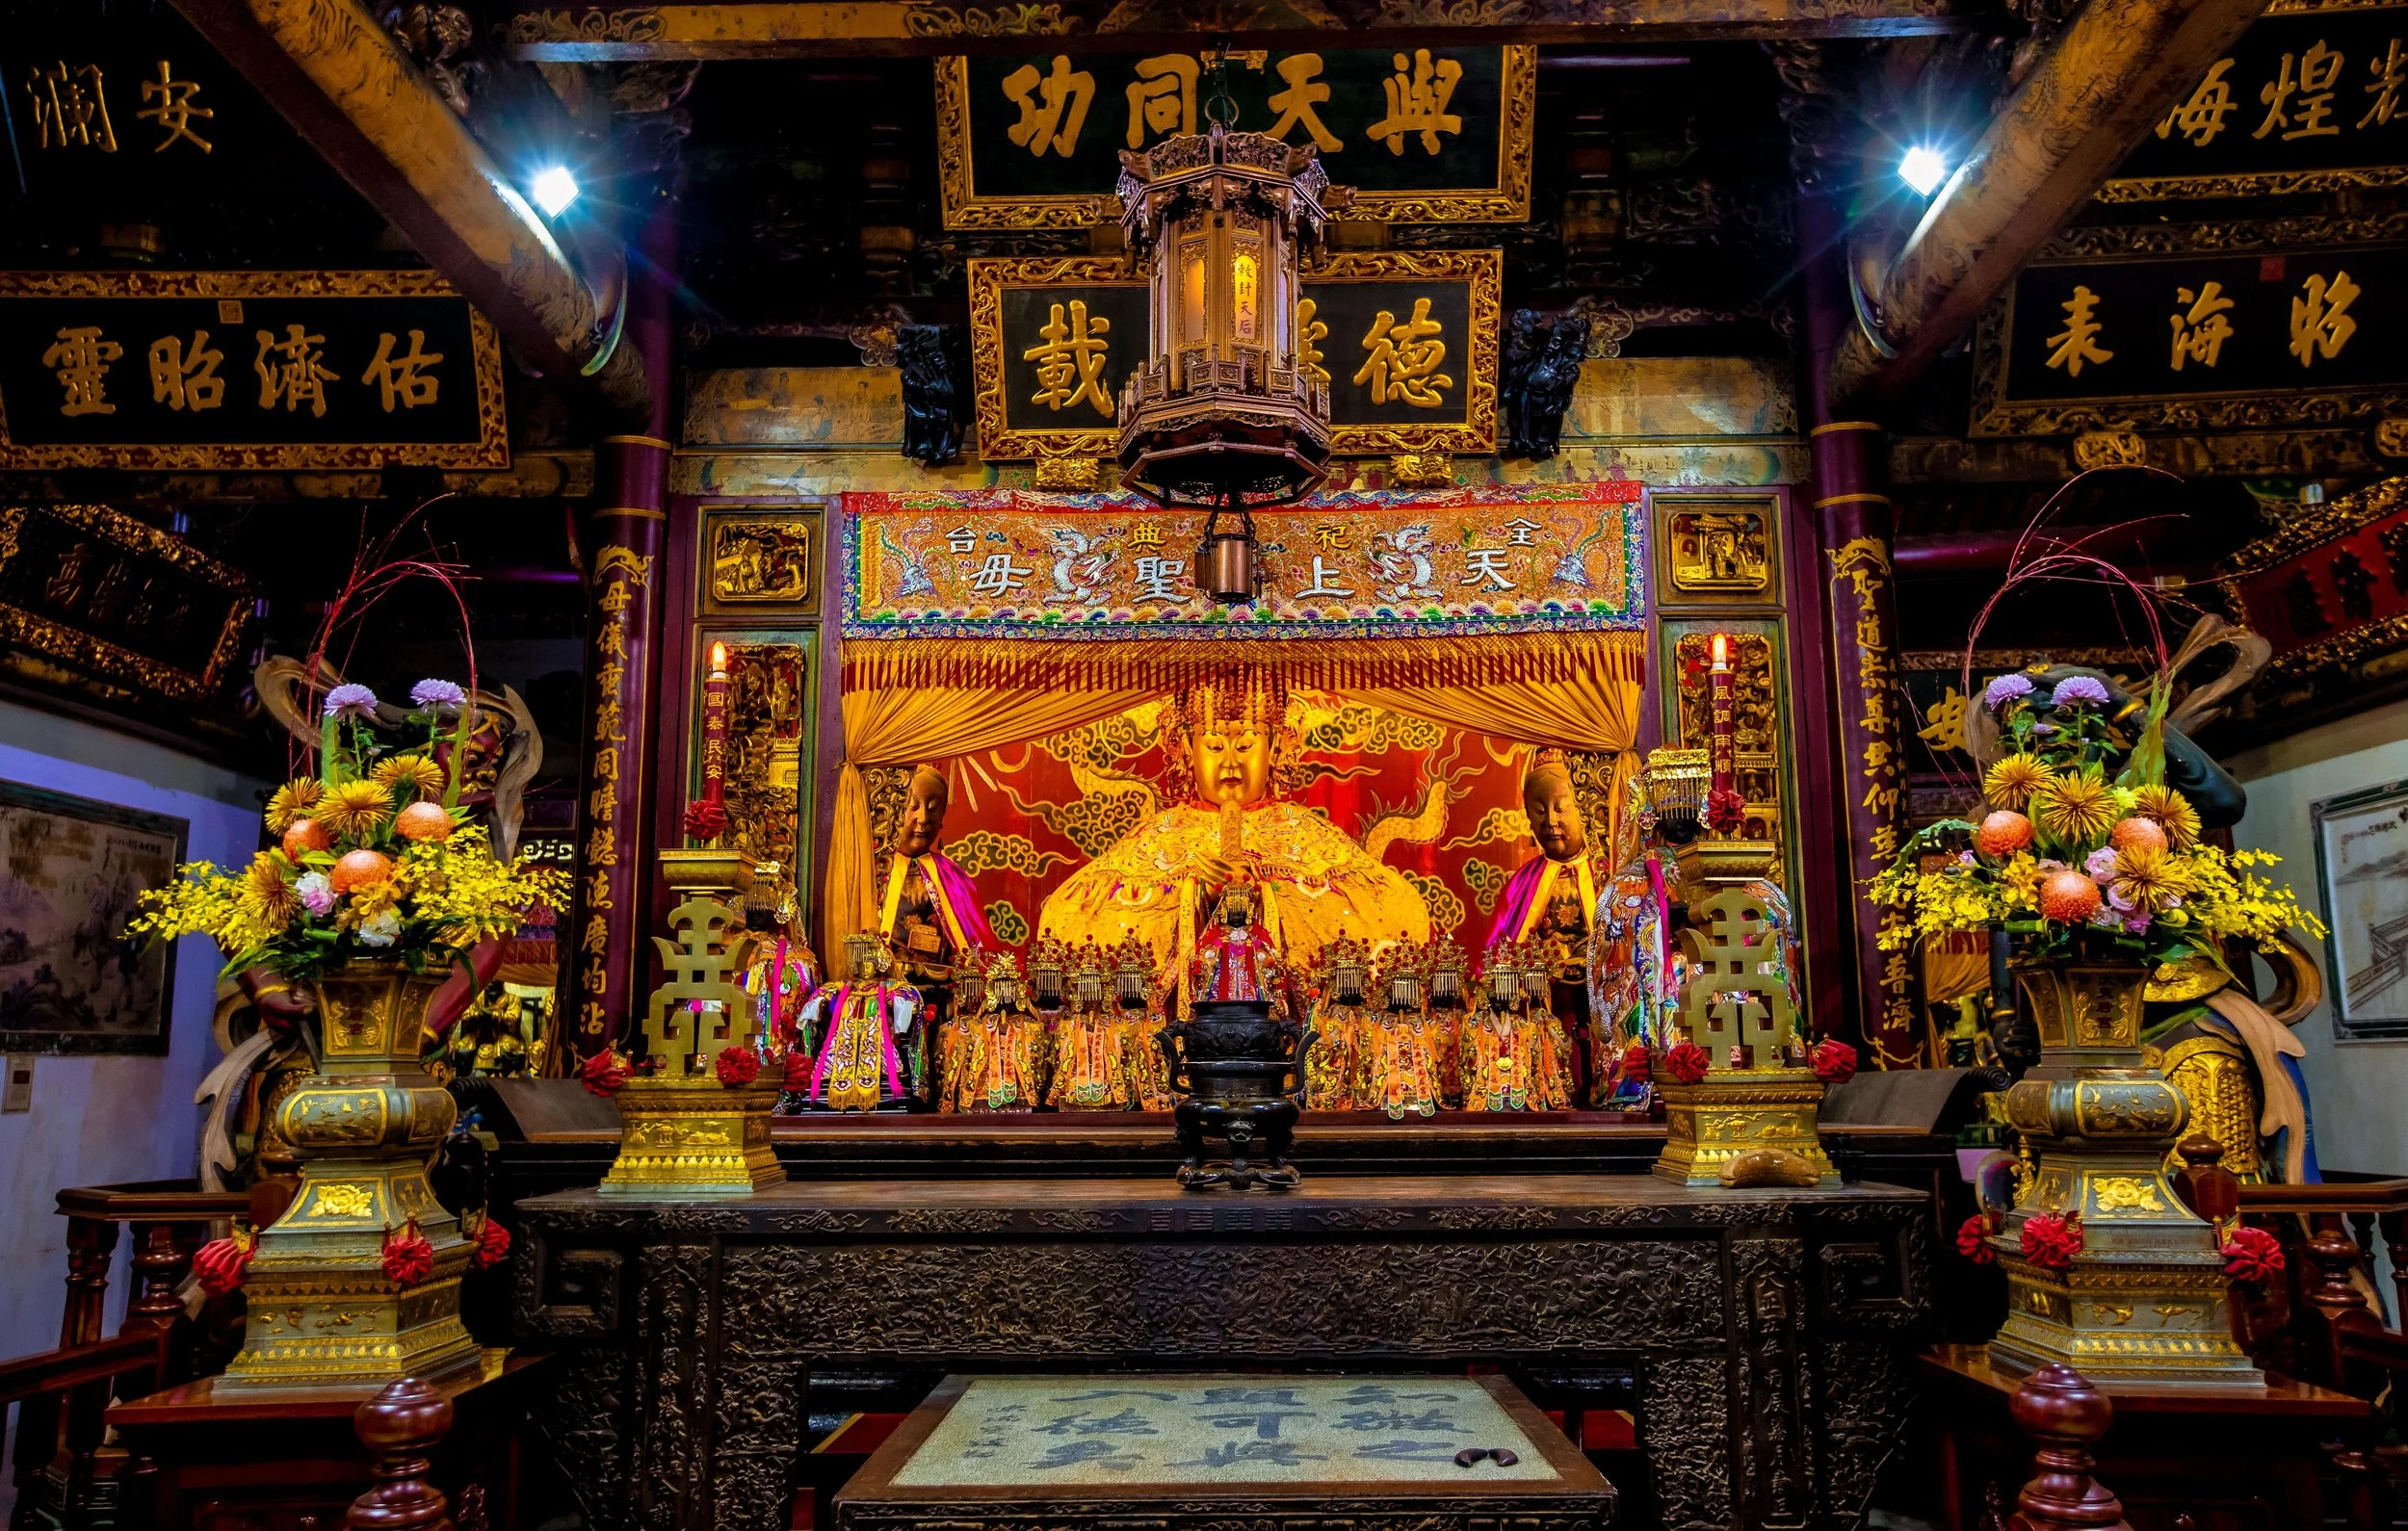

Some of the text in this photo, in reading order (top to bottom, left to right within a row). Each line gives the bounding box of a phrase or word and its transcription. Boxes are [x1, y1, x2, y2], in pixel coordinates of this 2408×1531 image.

[706, 692, 724, 779] 國泰民安
[1713, 686, 1732, 773] 風調雨順
